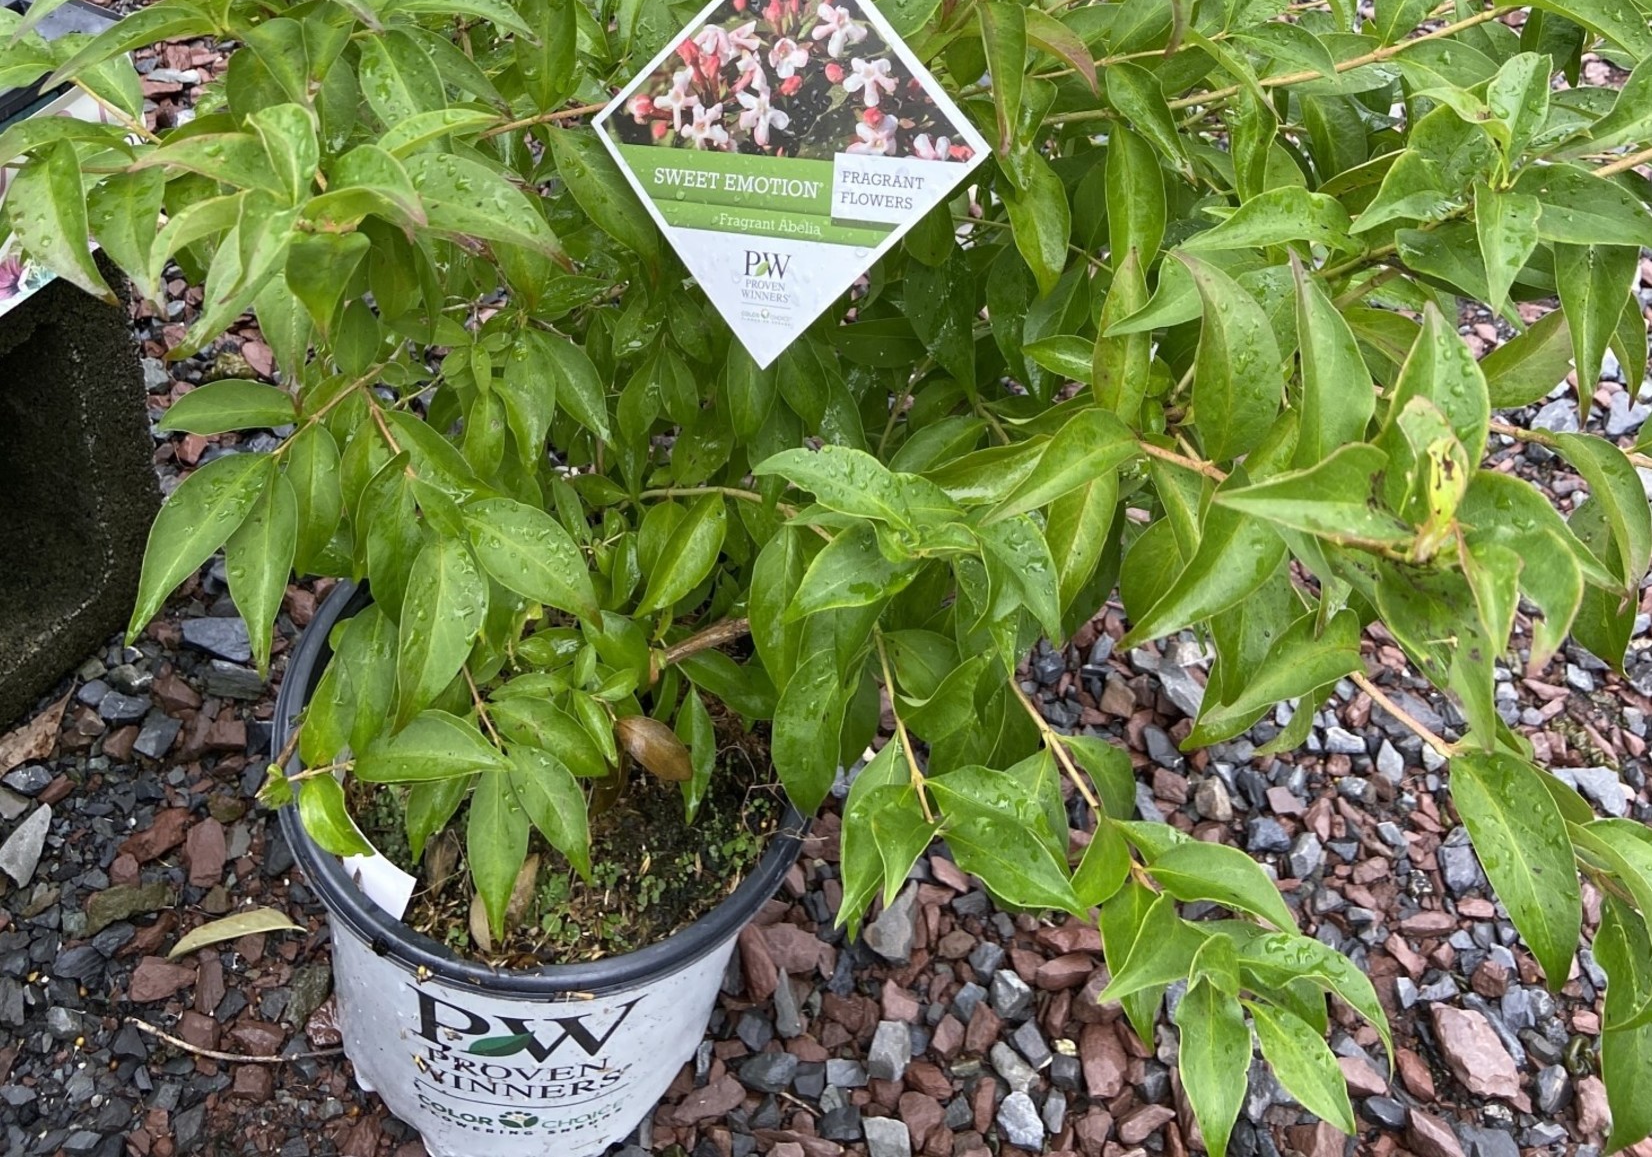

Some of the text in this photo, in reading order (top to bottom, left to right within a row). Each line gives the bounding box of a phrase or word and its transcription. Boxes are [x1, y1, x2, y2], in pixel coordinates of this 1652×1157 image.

[654, 167, 820, 199] SWEET EMOTION
[841, 170, 925, 190] FRAGRANT
[840, 191, 914, 210] FLOWERS
[718, 212, 822, 236] Fragrant Abelia
[744, 250, 792, 280] PW
[741, 289, 790, 304] WINNERS
[745, 279, 786, 292] PROVEN
[405, 982, 649, 1064] PW
[410, 1053, 623, 1100] WINNERS
[421, 1044, 610, 1082] PROVEN
[418, 1094, 494, 1127] COLOR
